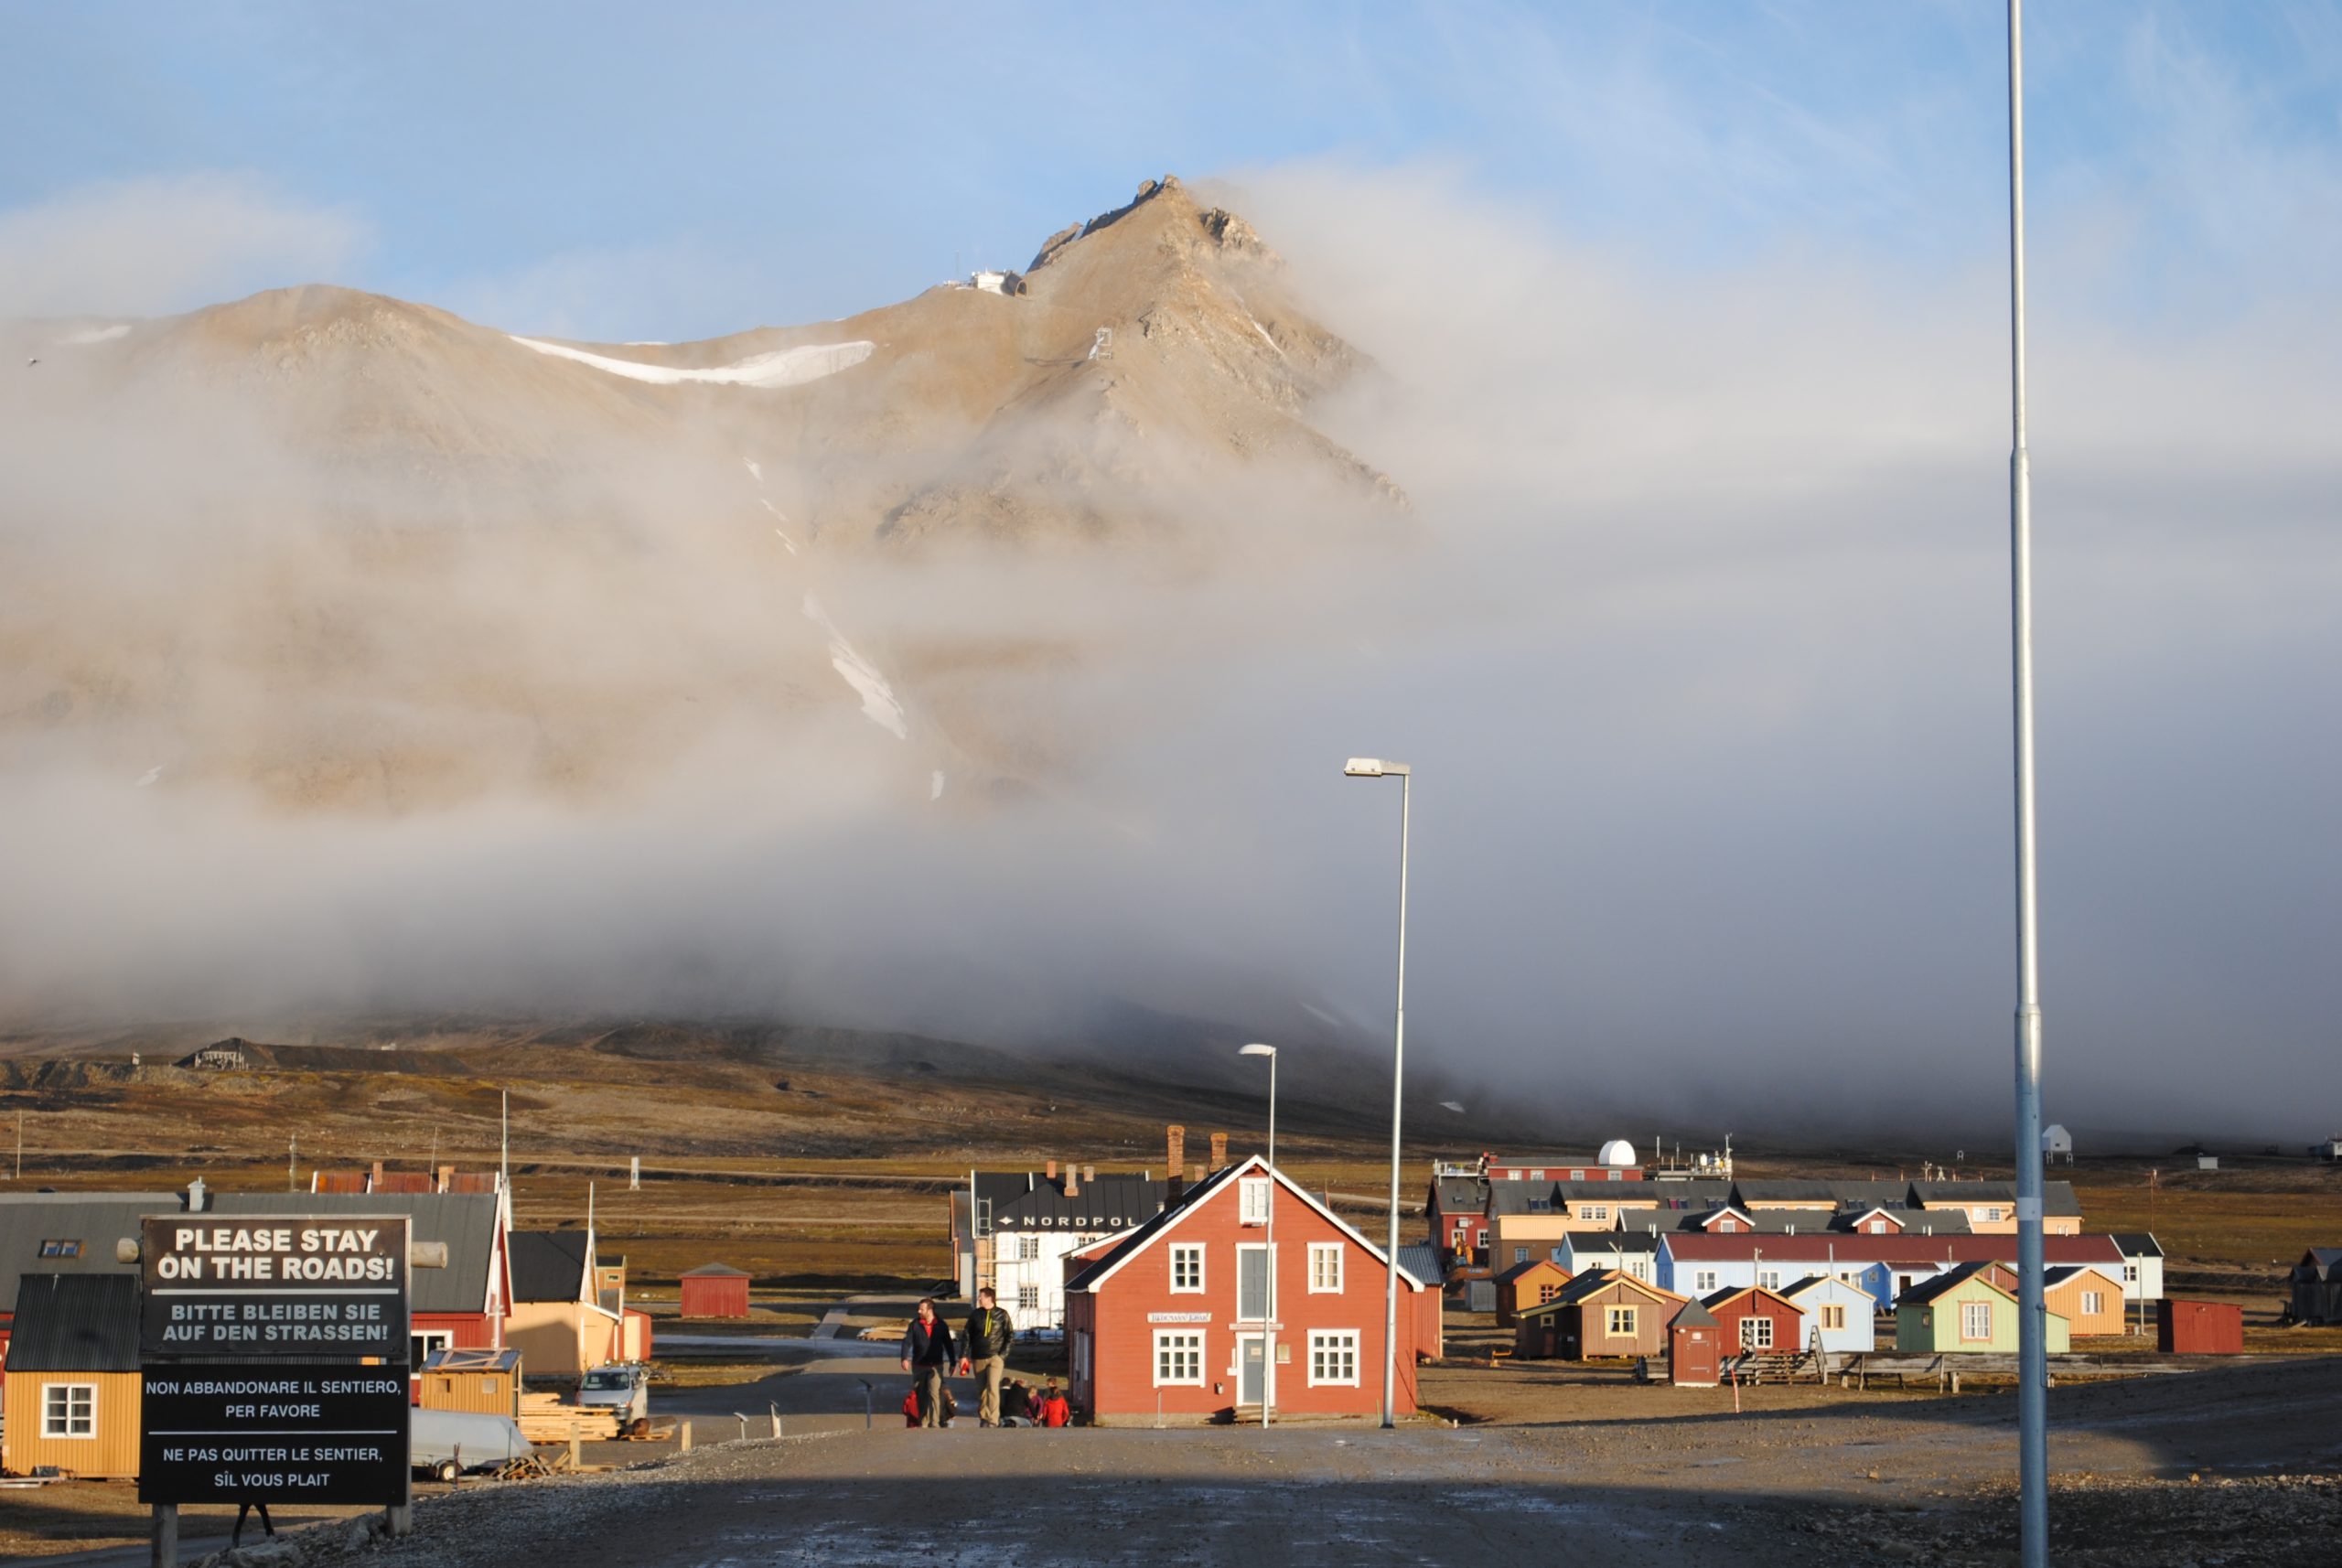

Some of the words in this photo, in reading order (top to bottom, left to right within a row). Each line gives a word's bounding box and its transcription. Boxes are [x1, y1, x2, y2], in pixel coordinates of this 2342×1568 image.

[1023, 1216, 1136, 1227] NORDPOL
[176, 1229, 291, 1251] PLEASE
[300, 1230, 378, 1251] STAY
[157, 1257, 202, 1279] ON
[210, 1257, 272, 1279] THE
[282, 1257, 393, 1280] ROADS!
[171, 1305, 236, 1320] BITTE
[243, 1305, 338, 1320] BLEIBEN
[345, 1304, 381, 1320] SIE
[163, 1326, 206, 1341] AUF
[213, 1326, 257, 1341] DEN
[264, 1325, 388, 1341] STRASSEN!
[145, 1381, 179, 1394] NON
[183, 1381, 299, 1394] ABBANDONARE
[304, 1381, 317, 1394] IL
[321, 1380, 402, 1395] SENTIERO,
[225, 1404, 255, 1417] PER
[260, 1404, 320, 1417] FAVORE
[163, 1448, 184, 1461] NE
[188, 1448, 219, 1461] PAS
[222, 1448, 287, 1461] QUITTER
[291, 1448, 309, 1461] LE
[314, 1447, 383, 1462] SENTIER,
[241, 1473, 284, 1487] VOUS
[287, 1473, 330, 1487] PLAIT
